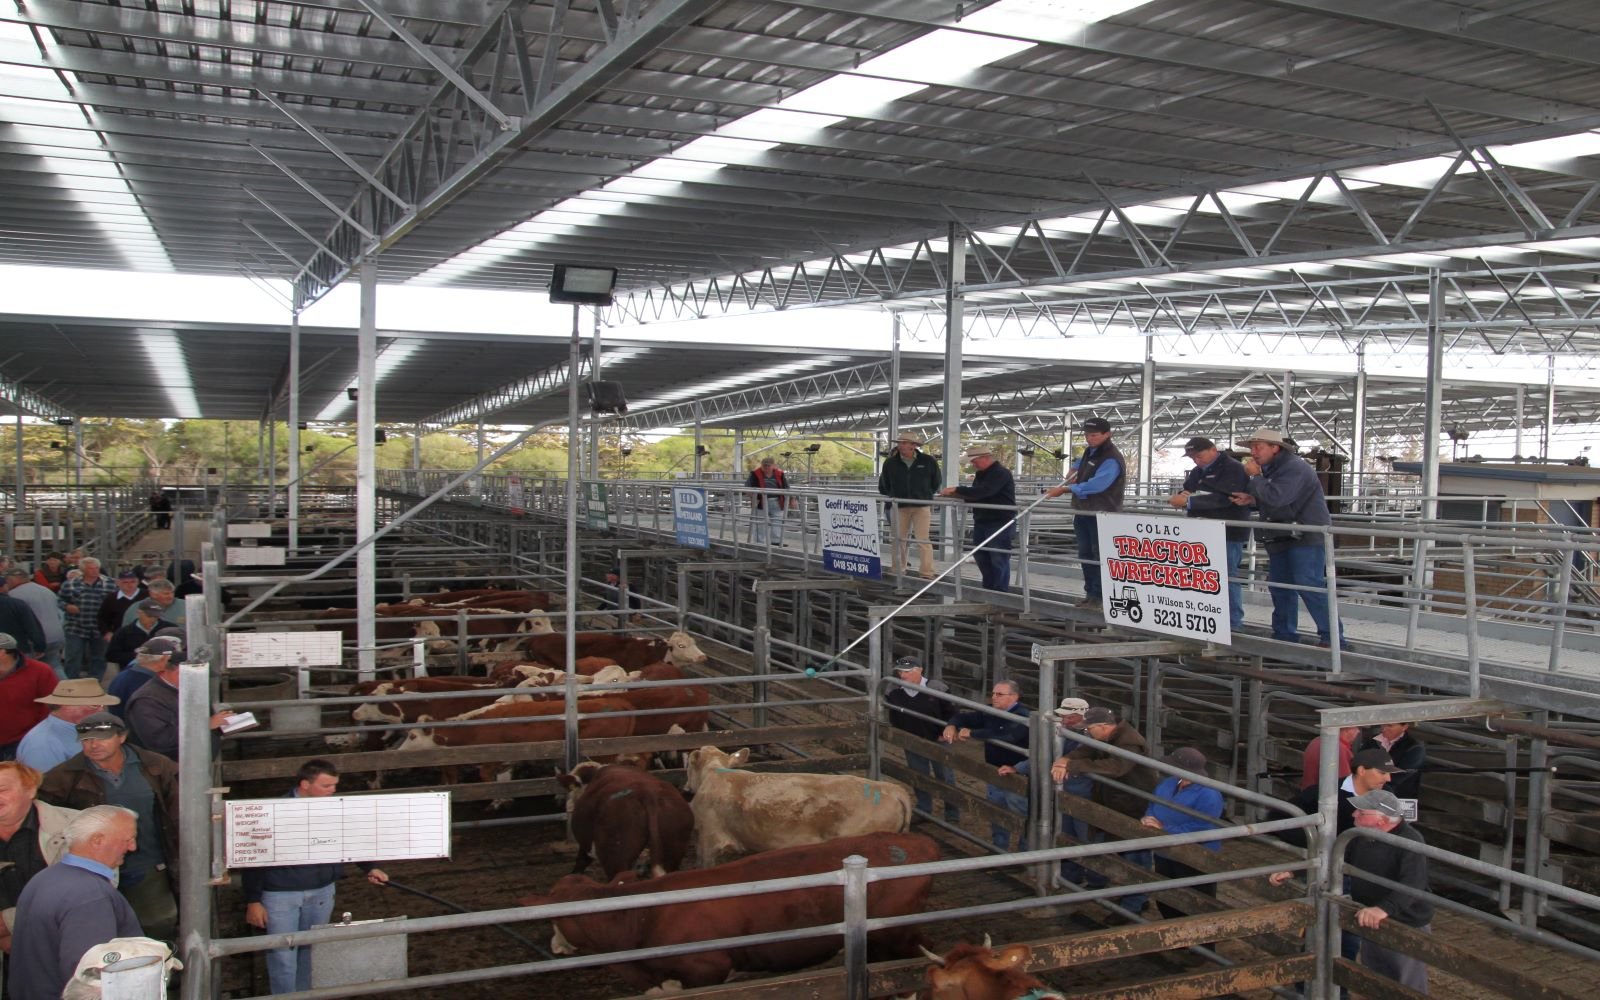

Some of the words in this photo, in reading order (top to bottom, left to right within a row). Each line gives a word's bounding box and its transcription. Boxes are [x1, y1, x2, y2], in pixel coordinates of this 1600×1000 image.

[825, 499, 842, 509] Geoff
[843, 501, 868, 514] Higgins
[831, 514, 864, 532] CARTAGE
[1136, 523, 1180, 536] COLAC
[823, 529, 877, 555] EARTHMOVING
[1113, 535, 1210, 566] TRACTOR
[833, 559, 846, 569] 0418
[846, 562, 856, 572] 524
[857, 563, 869, 574] 874
[1107, 558, 1220, 595] WRECKERS
[1147, 595, 1155, 603] 11
[1157, 596, 1183, 608] Wilson
[1185, 600, 1196, 611] St,
[1198, 602, 1222, 614] Colac
[1154, 609, 1183, 629] 5231
[1186, 613, 1217, 635] 5719
